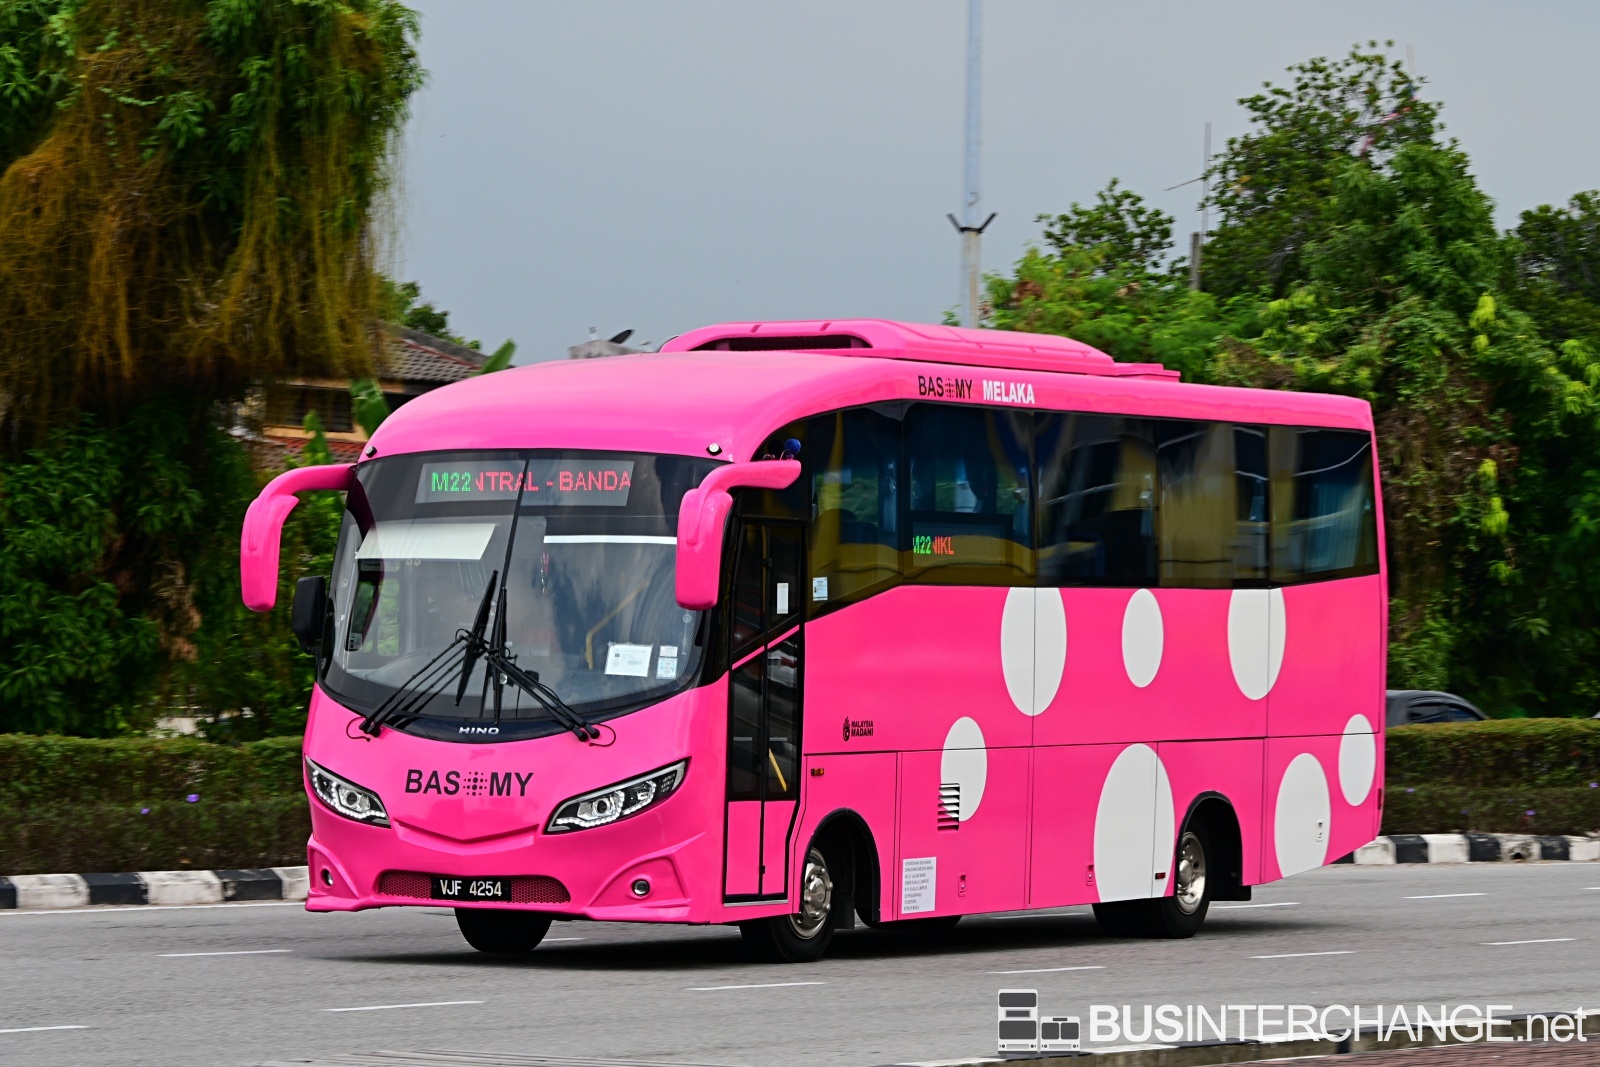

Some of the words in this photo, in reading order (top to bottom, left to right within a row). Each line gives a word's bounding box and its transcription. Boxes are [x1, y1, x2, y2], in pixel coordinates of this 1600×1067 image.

[918, 375, 944, 397] BAS
[955, 378, 973, 399] MY
[982, 379, 1036, 405] MELAKA
[431, 471, 471, 492] M22
[559, 470, 631, 491] BANDA
[458, 726, 500, 735] HINO
[851, 720, 874, 728] MALAYSIA
[851, 728, 874, 737] MADANI
[404, 769, 461, 796] BAS
[489, 772, 534, 797] MY
[440, 879, 463, 896] VJF
[469, 880, 502, 897] 4254
